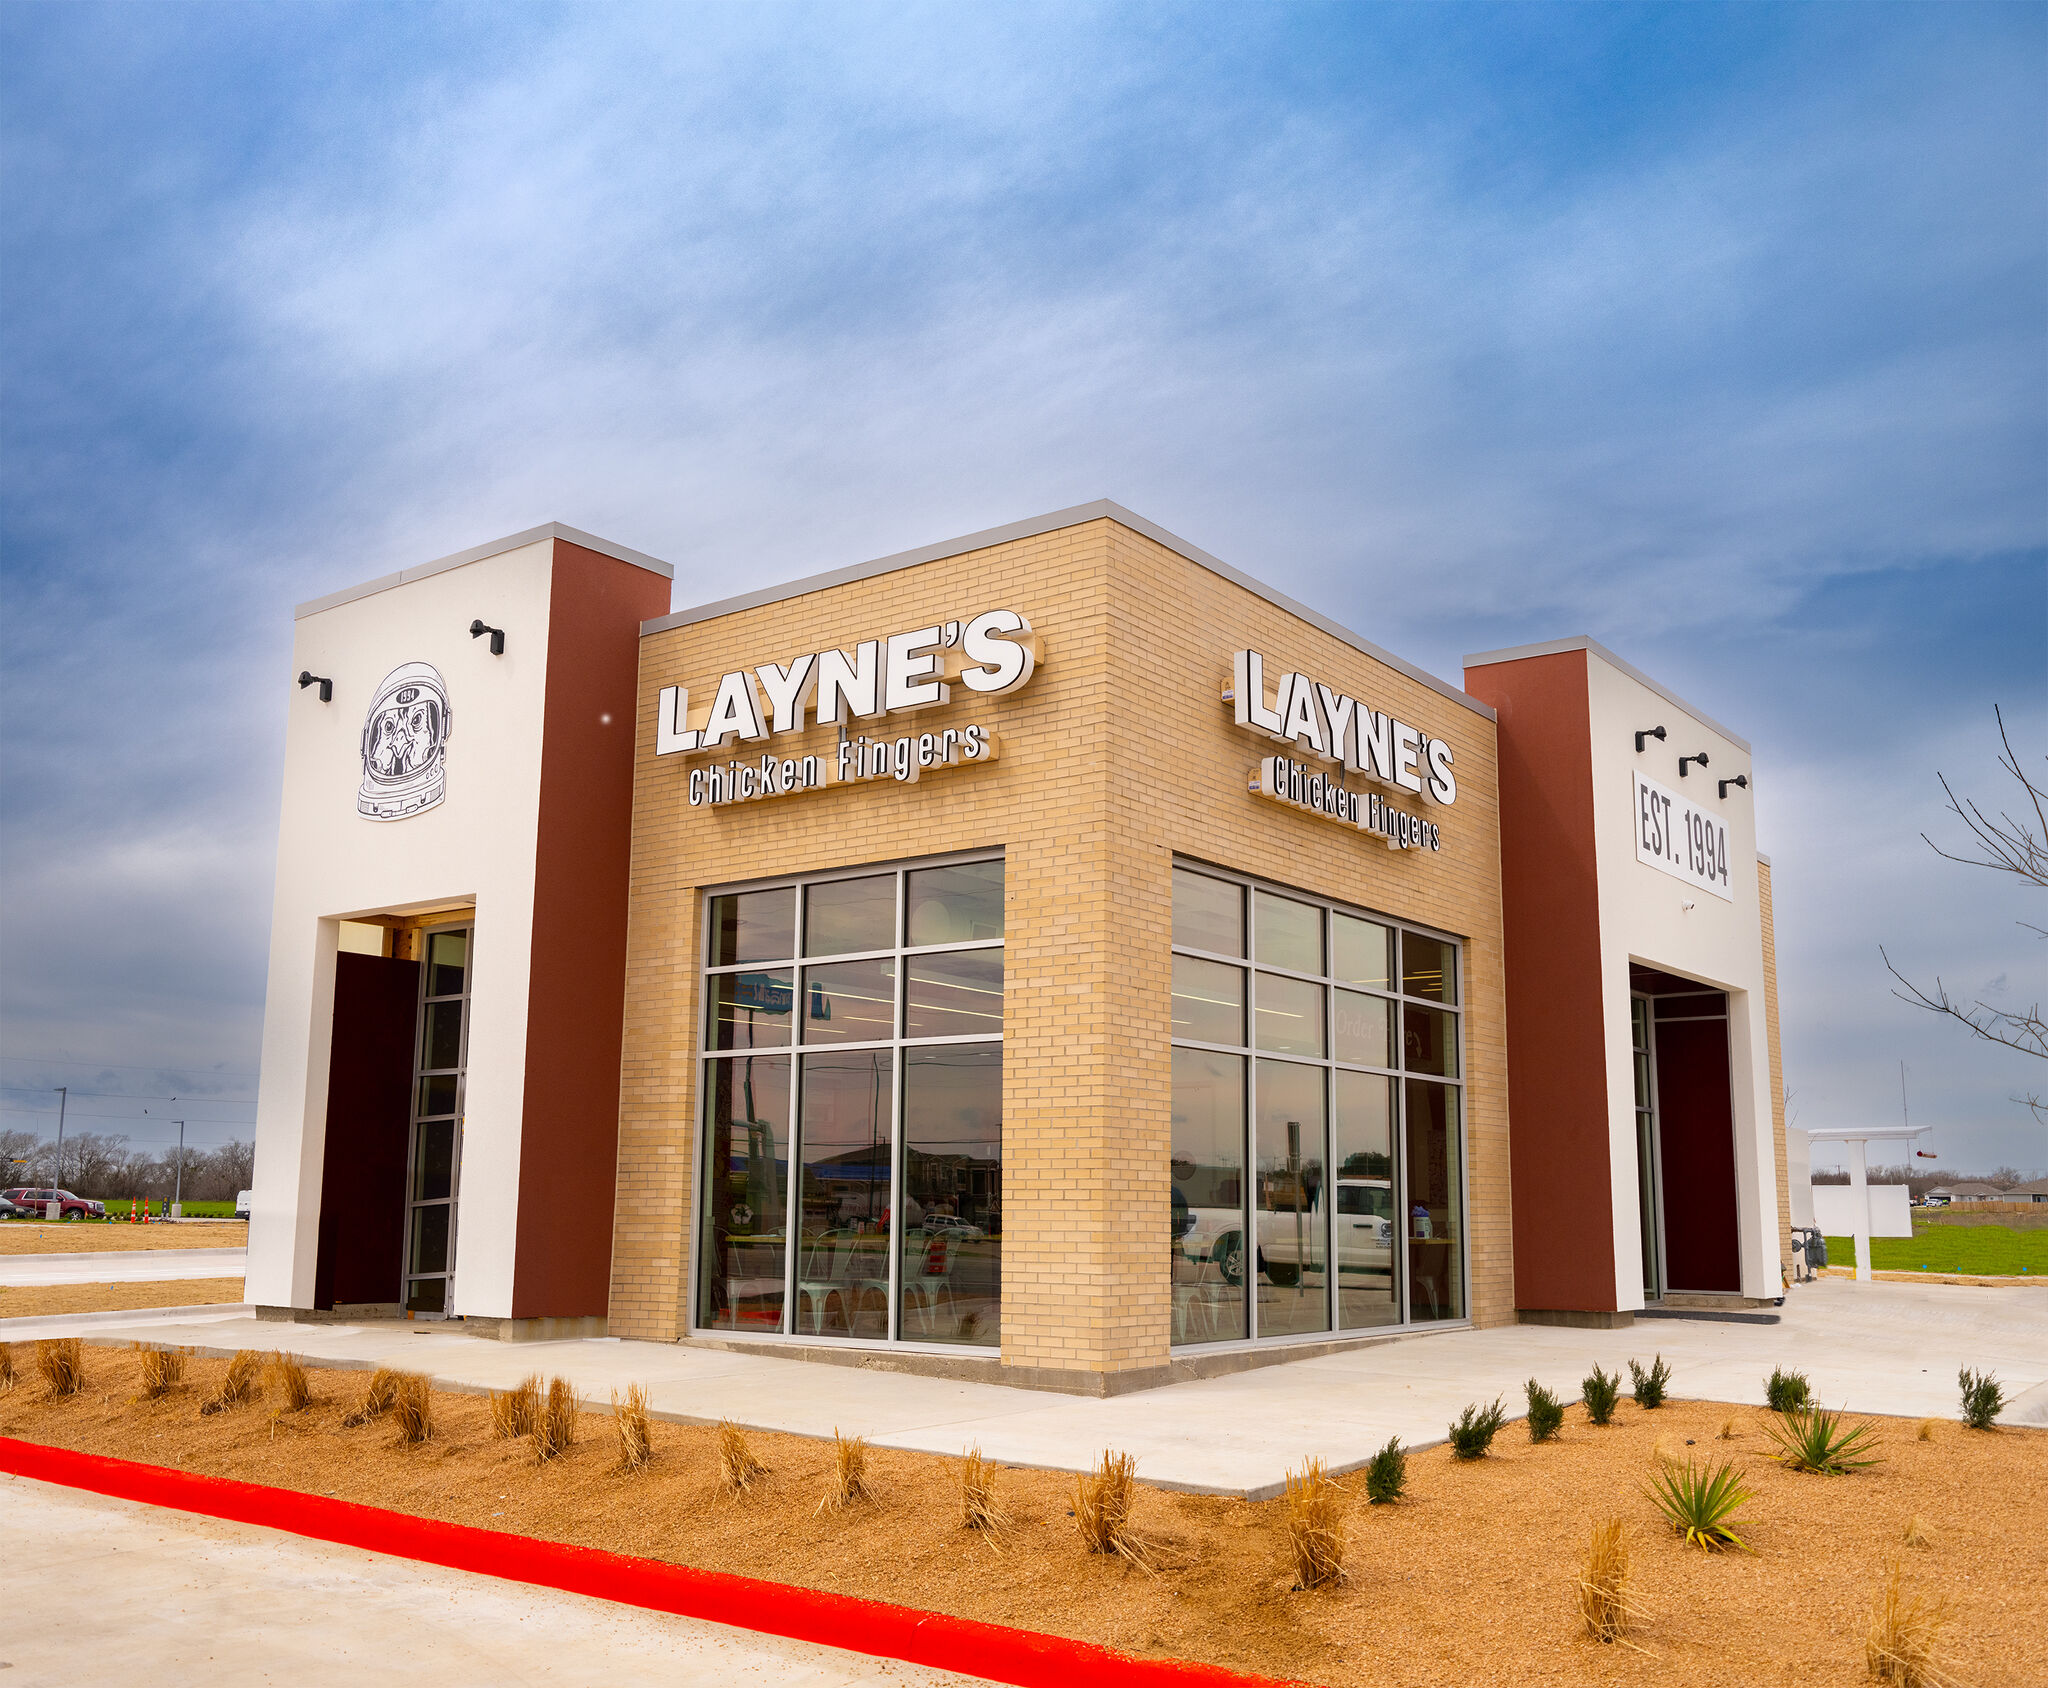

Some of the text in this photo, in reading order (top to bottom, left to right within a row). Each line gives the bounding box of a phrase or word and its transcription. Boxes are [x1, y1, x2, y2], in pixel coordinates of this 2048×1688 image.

[656, 609, 1027, 756] LAYNE'S
[1245, 649, 1457, 805] LAYNE'S
[688, 723, 983, 806] Chicken Fingers
[1272, 755, 1441, 852] Chicken Fingers
[1640, 783, 1728, 887] EST. 1994
